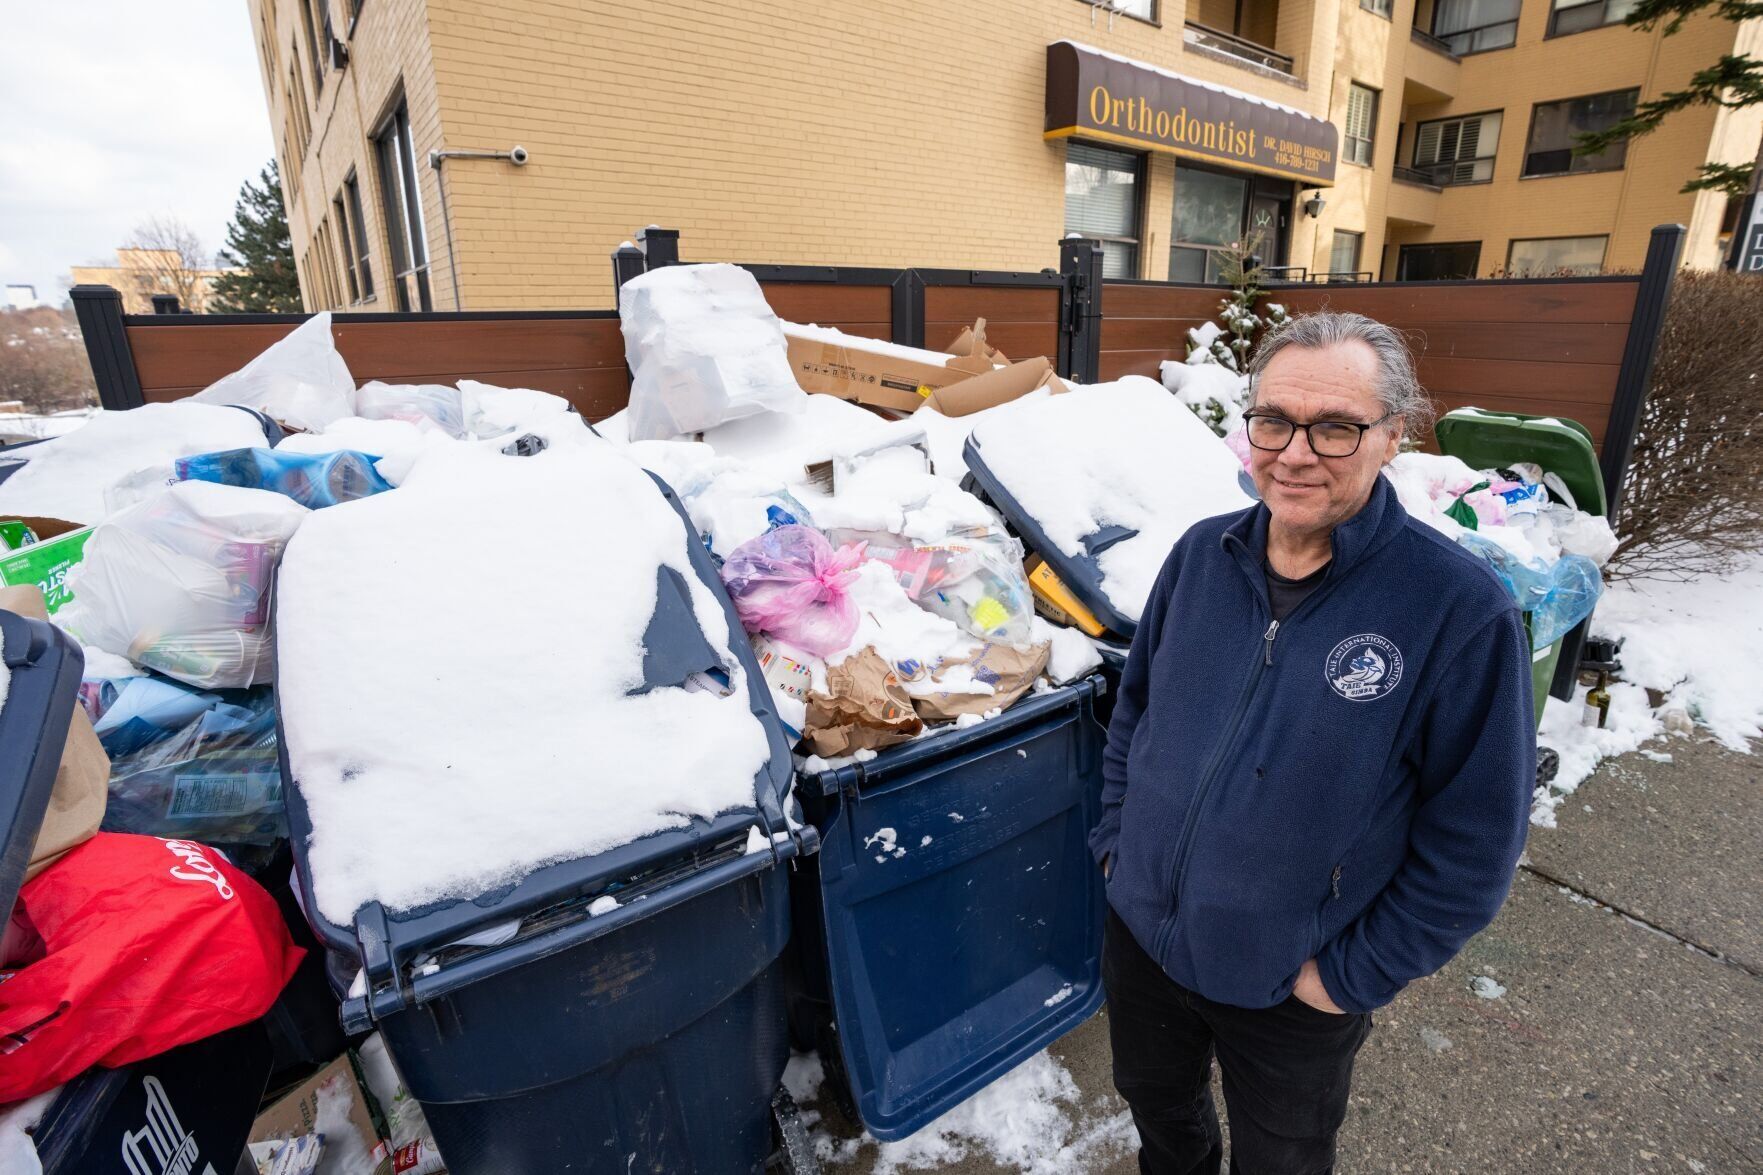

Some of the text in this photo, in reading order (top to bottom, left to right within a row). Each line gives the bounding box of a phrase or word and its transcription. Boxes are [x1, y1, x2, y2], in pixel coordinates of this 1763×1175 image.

[1090, 86, 1256, 158] Orthodontist
[1264, 136, 1277, 150] DR.
[1280, 140, 1302, 155] DAVID
[1329, 635, 1401, 690] TAIE INTERNATIONAL INSTITUTE
[1341, 682, 1362, 690] TAIE
